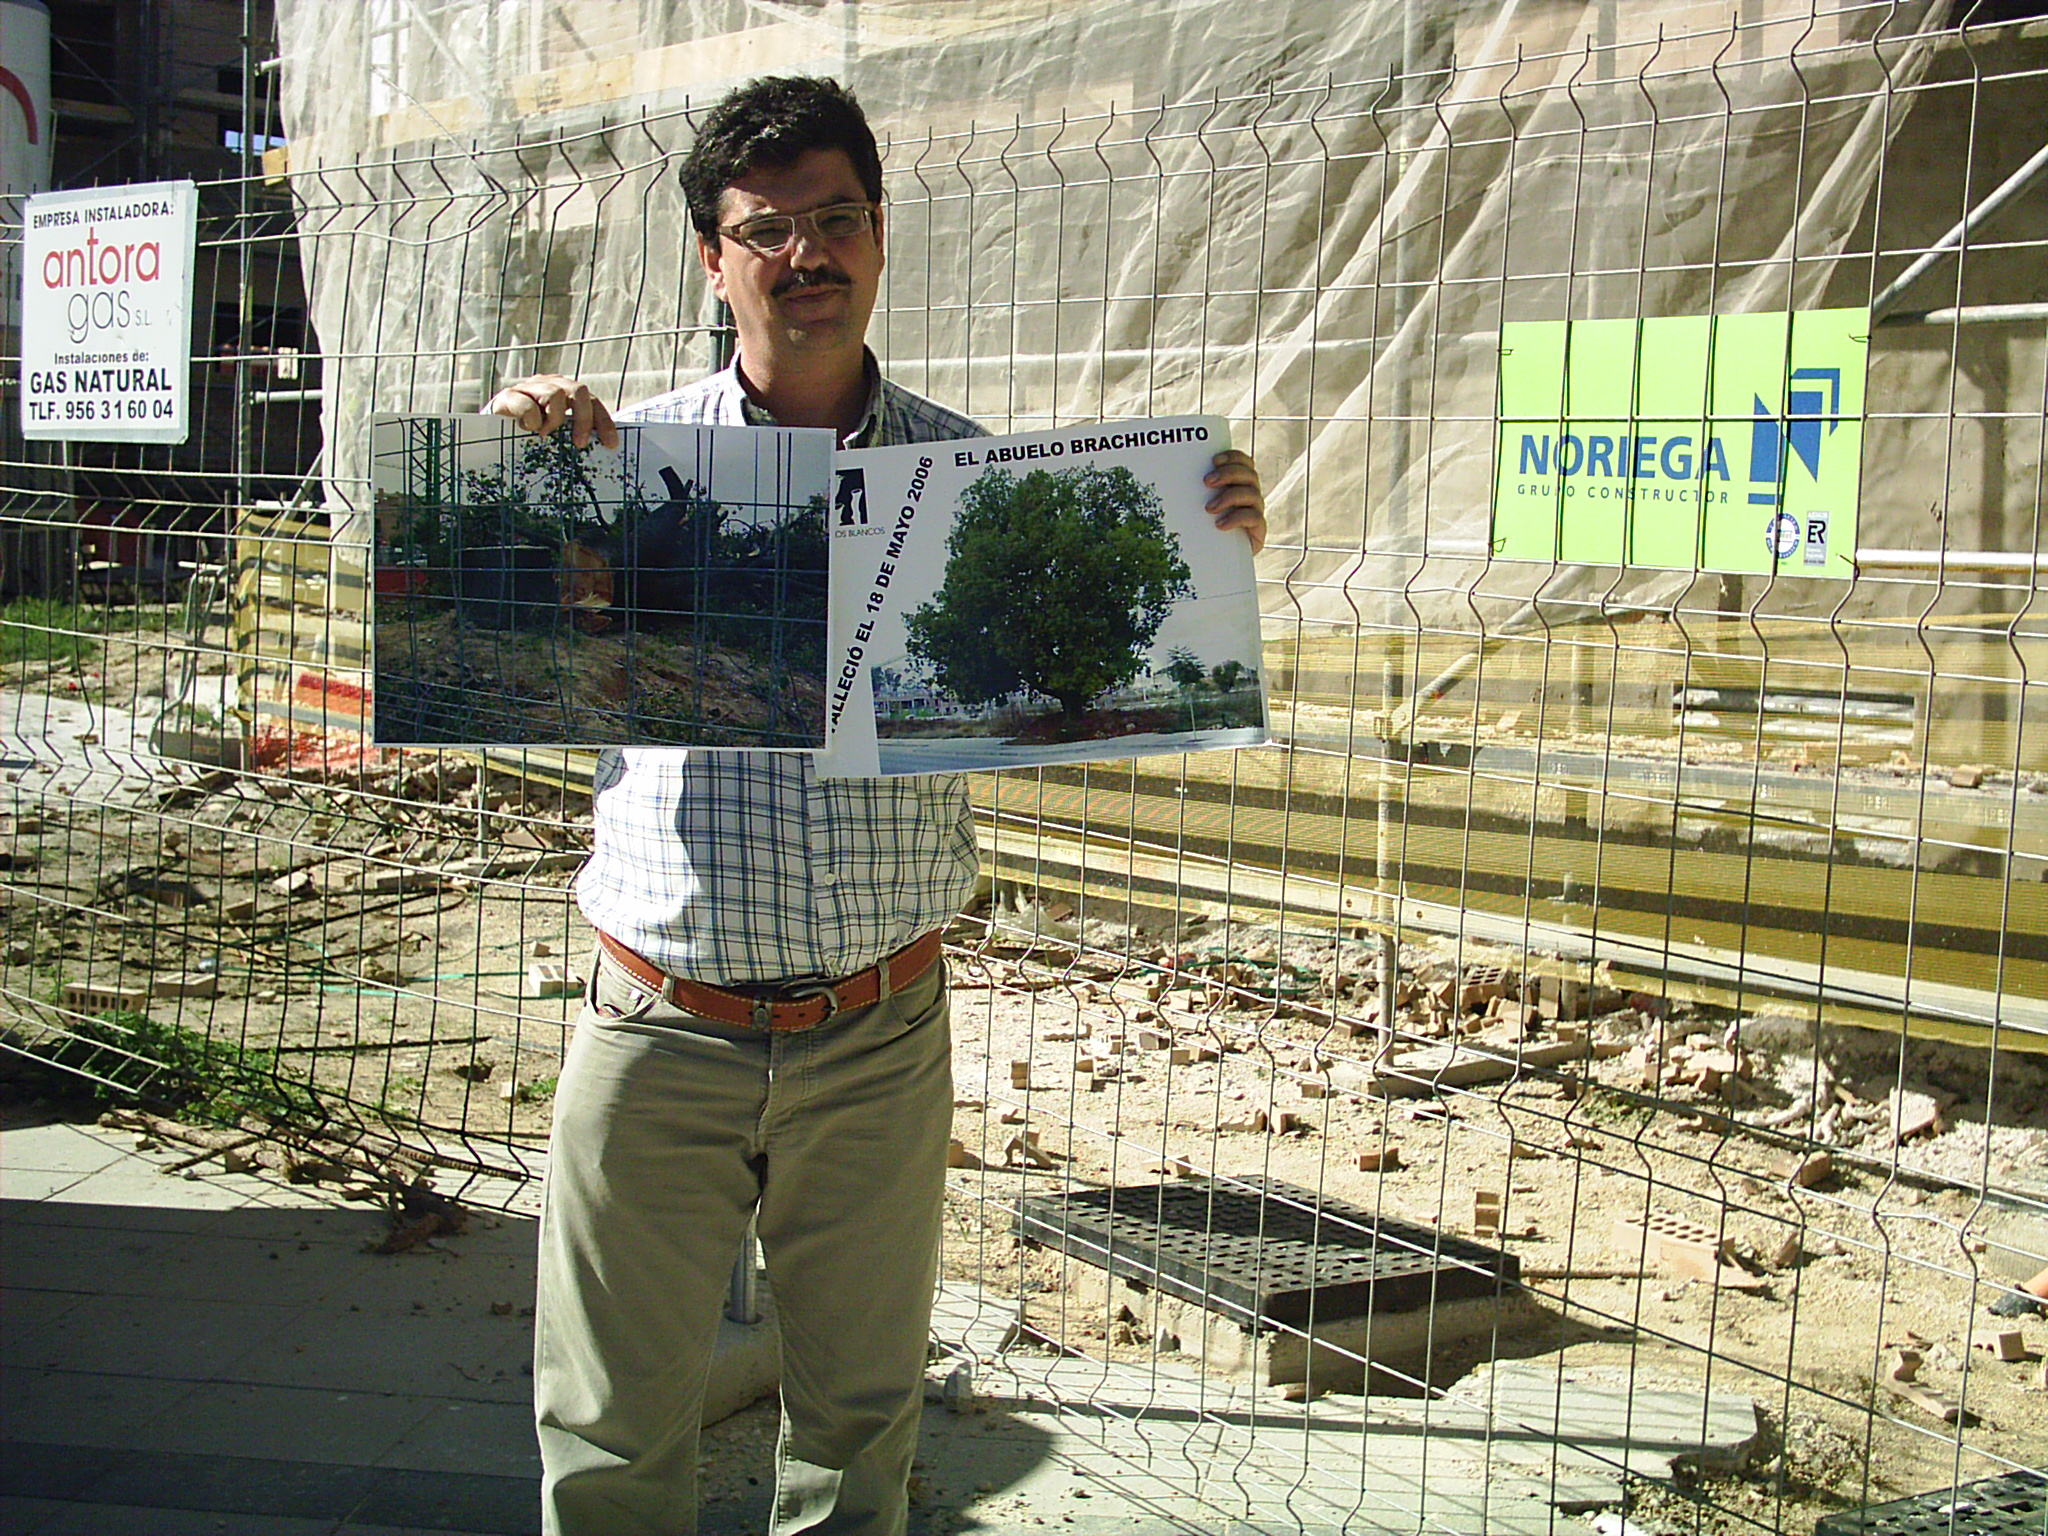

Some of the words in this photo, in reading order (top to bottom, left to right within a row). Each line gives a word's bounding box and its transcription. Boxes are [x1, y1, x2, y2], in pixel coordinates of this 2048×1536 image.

[33, 210, 80, 229] EMPRESA
[85, 201, 174, 224] INSTALADORA:
[43, 226, 160, 289] antora
[68, 290, 131, 344] gas
[54, 351, 128, 365] Instalaciones
[132, 349, 149, 362] de:
[30, 371, 67, 394] GAS
[75, 368, 172, 393] NATURAL
[29, 401, 60, 420] TLF.
[65, 400, 95, 420] 956
[153, 398, 173, 419] 04
[954, 452, 980, 467] EL
[985, 441, 1065, 464] ABUELO
[1070, 426, 1209, 454] BRACHICHITO
[1519, 434, 1731, 481] NORIEGA
[1587, 486, 1729, 504] CONSTRUCTOR
[831, 646, 864, 734] ALLECIÓ
[855, 620, 875, 643] EL
[866, 591, 884, 613] 18
[875, 561, 896, 588] DE
[886, 505, 915, 559] MAYO
[907, 456, 933, 502] 2006
